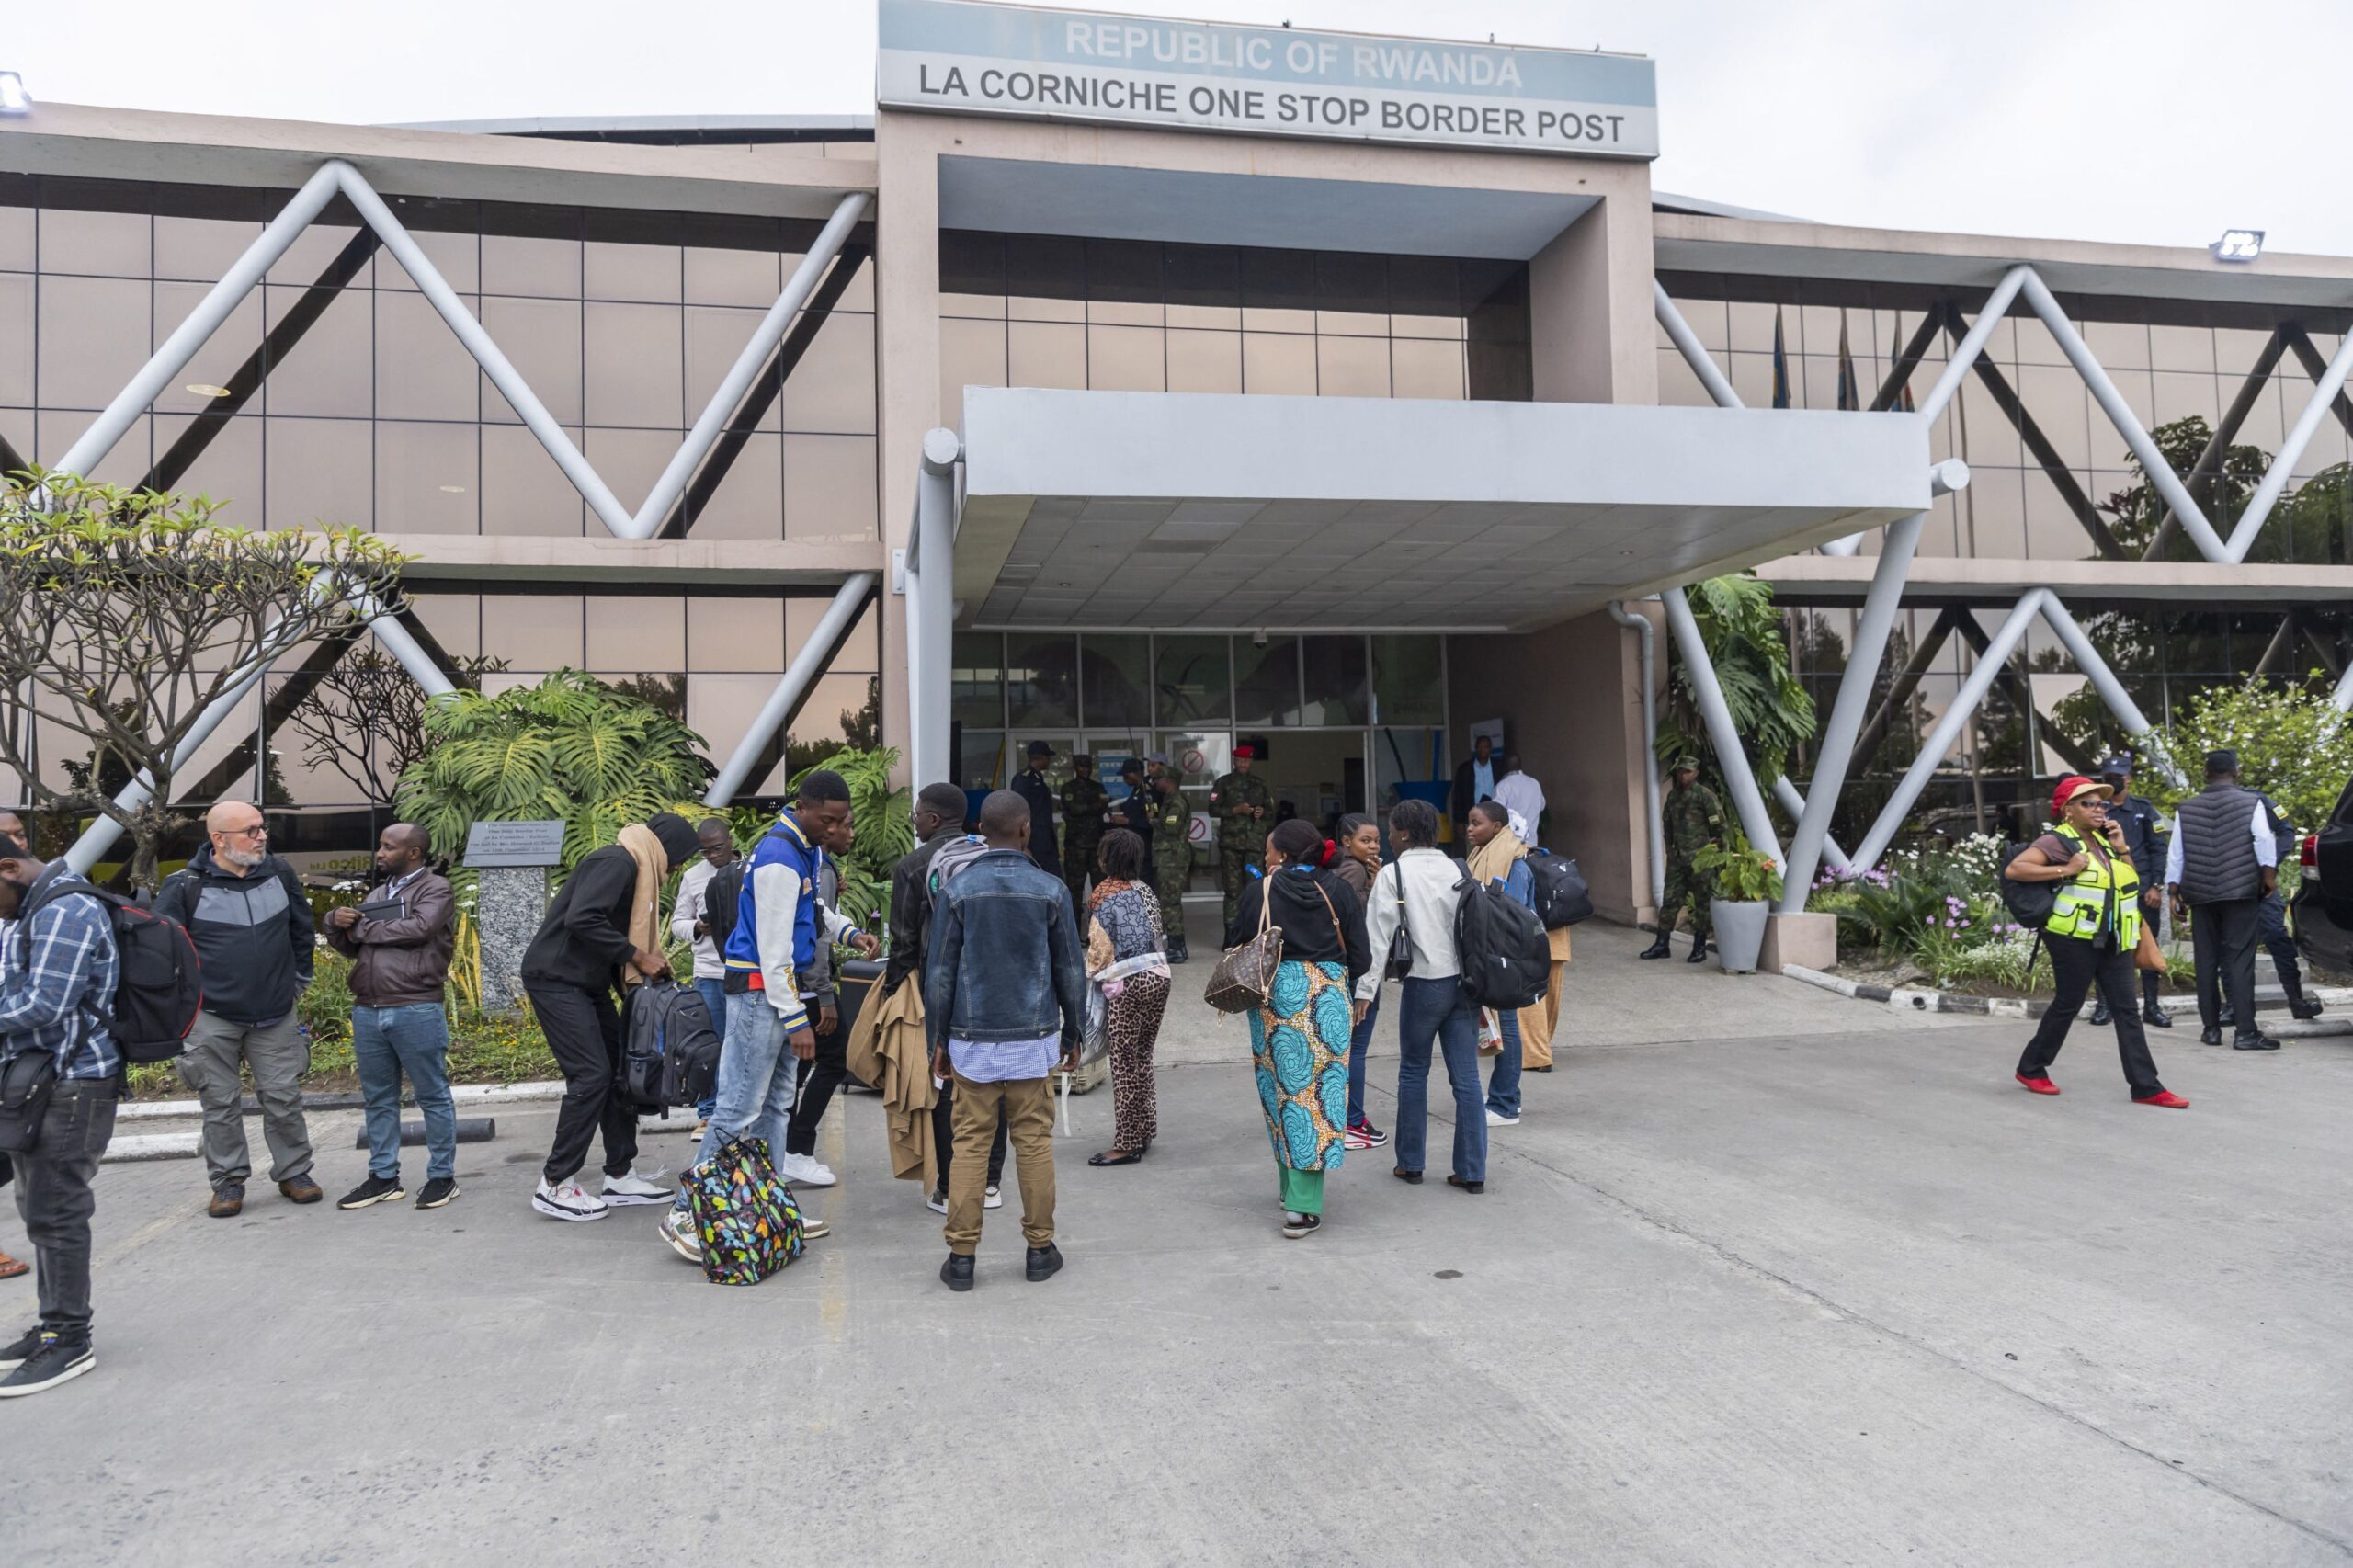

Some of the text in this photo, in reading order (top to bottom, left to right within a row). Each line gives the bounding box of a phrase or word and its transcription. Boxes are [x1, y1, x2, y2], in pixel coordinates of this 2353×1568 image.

[1066, 21, 1523, 88] REPUBLIC OF RWANDA
[920, 64, 1625, 142] LA CORNICHE ONE STOP BORDER POST
